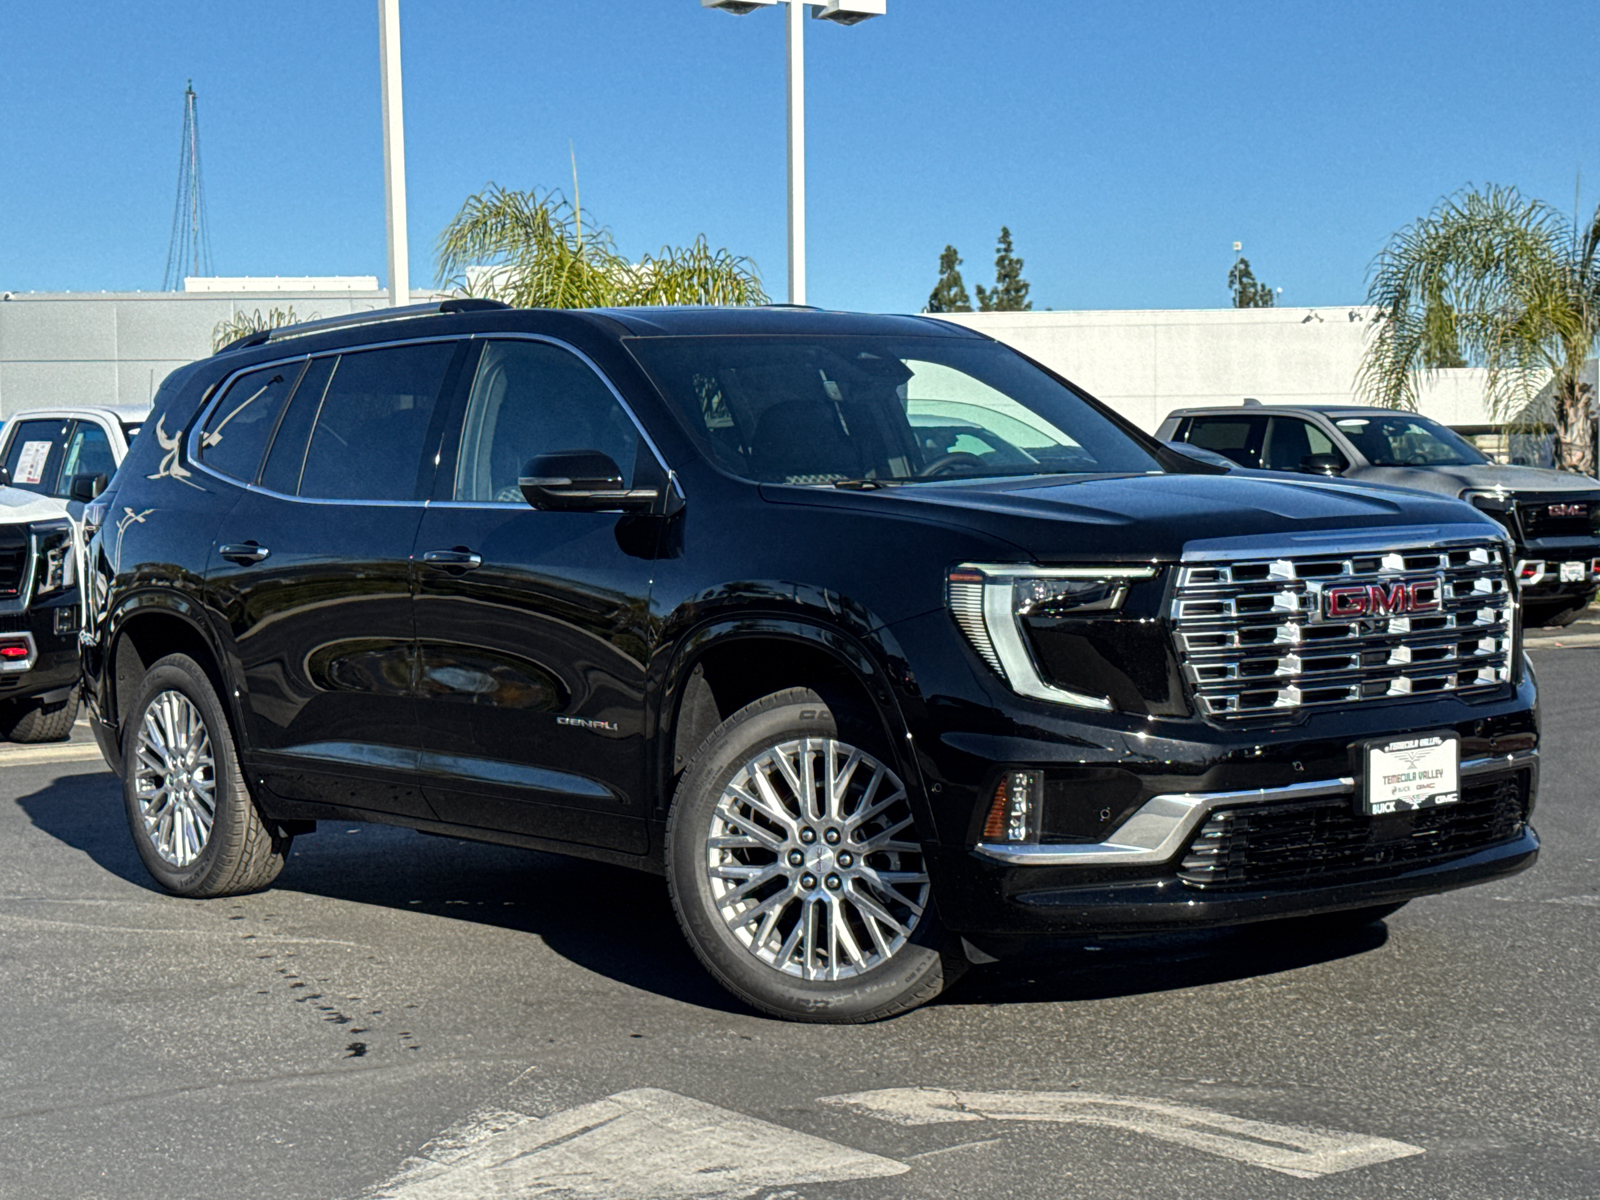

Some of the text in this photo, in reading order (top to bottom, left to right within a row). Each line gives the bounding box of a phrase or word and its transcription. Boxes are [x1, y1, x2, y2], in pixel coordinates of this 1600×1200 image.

[1548, 504, 1588, 516] GMC
[1327, 580, 1440, 618] GMC
[556, 716, 618, 731] DENALI
[1382, 768, 1444, 785] TEMECULA VALLEY
[1416, 782, 1436, 790] GMC
[1435, 793, 1459, 804] GMC
[1371, 801, 1396, 815] BUICK
